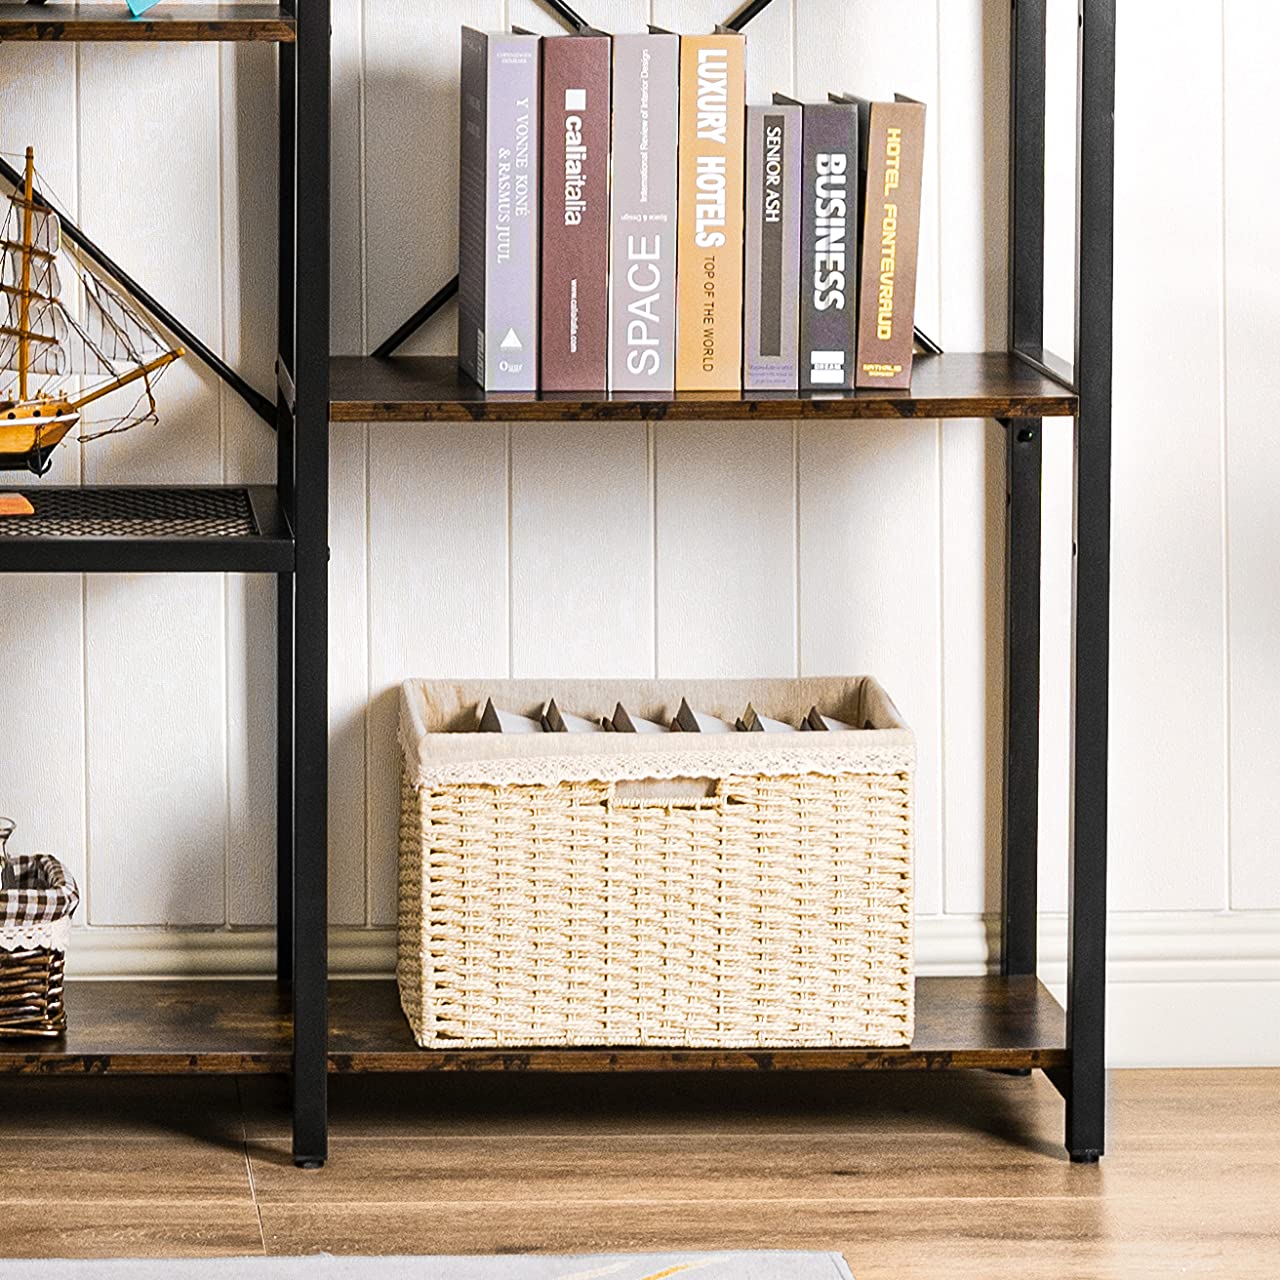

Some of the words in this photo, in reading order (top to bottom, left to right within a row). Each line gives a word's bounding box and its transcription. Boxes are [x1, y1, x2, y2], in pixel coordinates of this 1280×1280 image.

[641, 49, 651, 78] Design
[640, 110, 648, 119] of
[697, 49, 727, 144] LUXURY
[498, 147, 511, 159] &
[515, 115, 528, 168] VONNE
[640, 126, 648, 151] Review
[765, 126, 781, 186] SENIOR
[884, 127, 902, 197] HOTEL
[498, 163, 511, 223] RASMUS
[565, 115, 587, 226] caliaitalia
[640, 152, 648, 202] International
[515, 174, 531, 216] KONÉ
[695, 156, 726, 248] HOTELS
[765, 189, 780, 223] ASH
[496, 225, 510, 263] JUUL
[814, 153, 847, 311] BUSINESS
[704, 256, 715, 280] TOP
[704, 283, 715, 298] OF
[876, 203, 898, 340] FONTEVRAUD
[627, 235, 660, 376] SPACE
[703, 302, 714, 324] THE
[702, 328, 714, 372] WORLD
